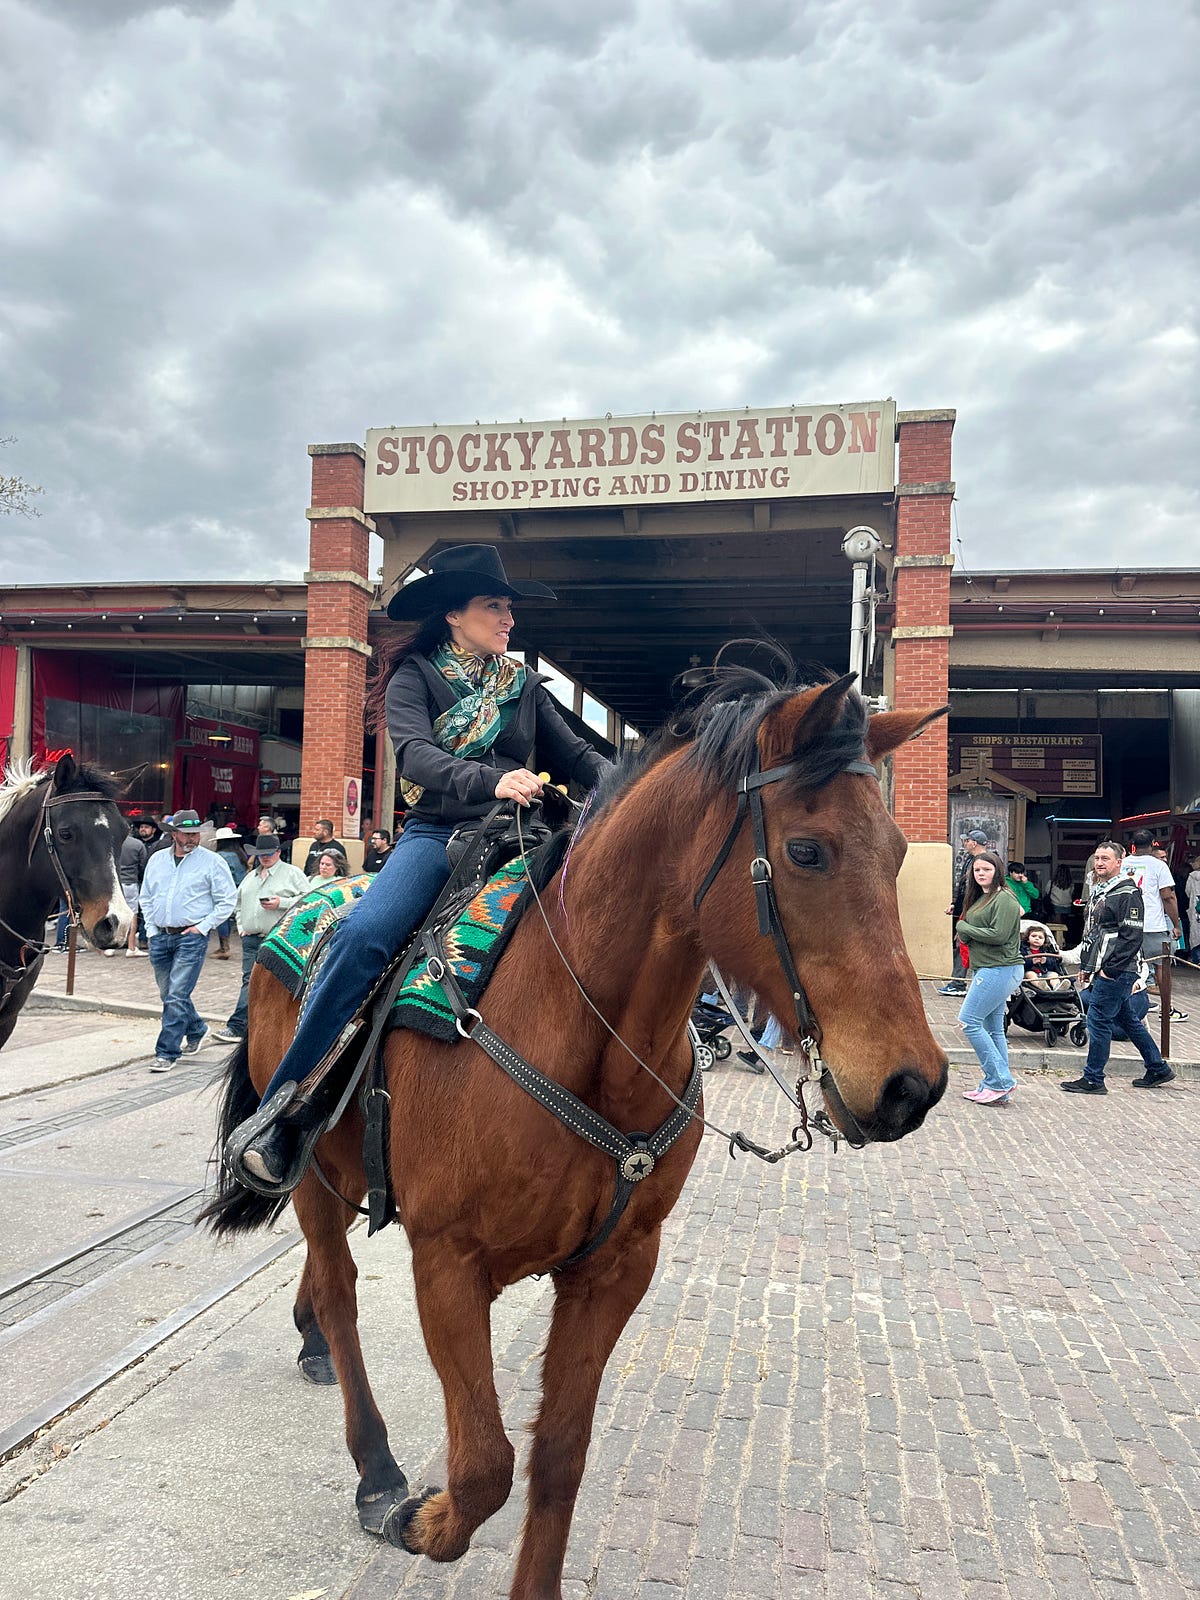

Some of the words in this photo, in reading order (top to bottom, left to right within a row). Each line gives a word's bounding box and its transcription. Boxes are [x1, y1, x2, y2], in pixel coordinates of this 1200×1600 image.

[377, 426, 665, 476] STOCKYARDS
[676, 411, 880, 464] STATION
[452, 477, 601, 501] SHOPPING
[608, 473, 671, 496] AND
[679, 466, 790, 493] DINING
[973, 736, 1002, 745] SHOPS
[1004, 737, 1011, 745] &
[1013, 737, 1084, 745] RESTAURANTS
